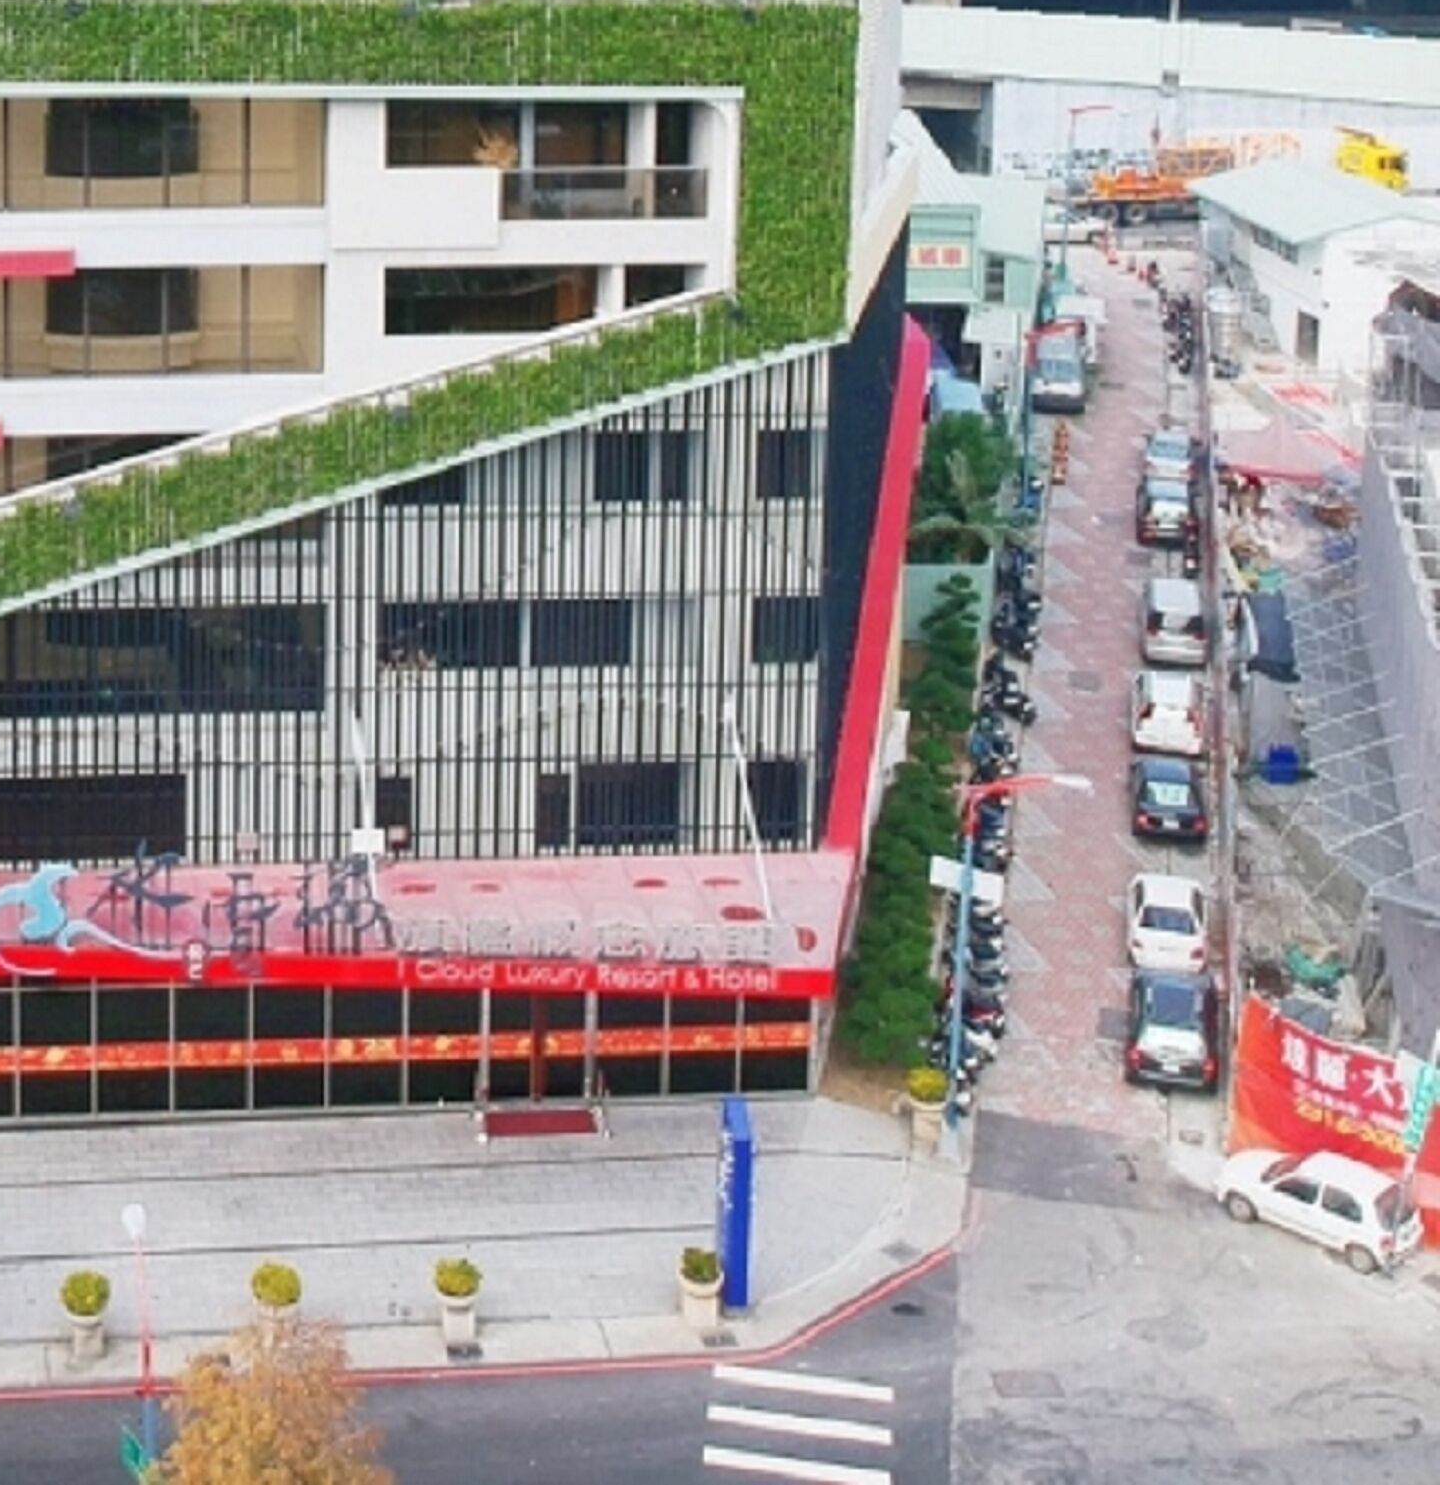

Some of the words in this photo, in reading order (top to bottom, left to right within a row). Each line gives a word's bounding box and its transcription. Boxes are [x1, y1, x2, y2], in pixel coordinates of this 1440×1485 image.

[415, 960, 494, 981] Cloud
[505, 962, 587, 990] Luxury
[597, 963, 677, 988] Resort
[684, 971, 700, 989] &
[710, 968, 777, 991] Hotel
